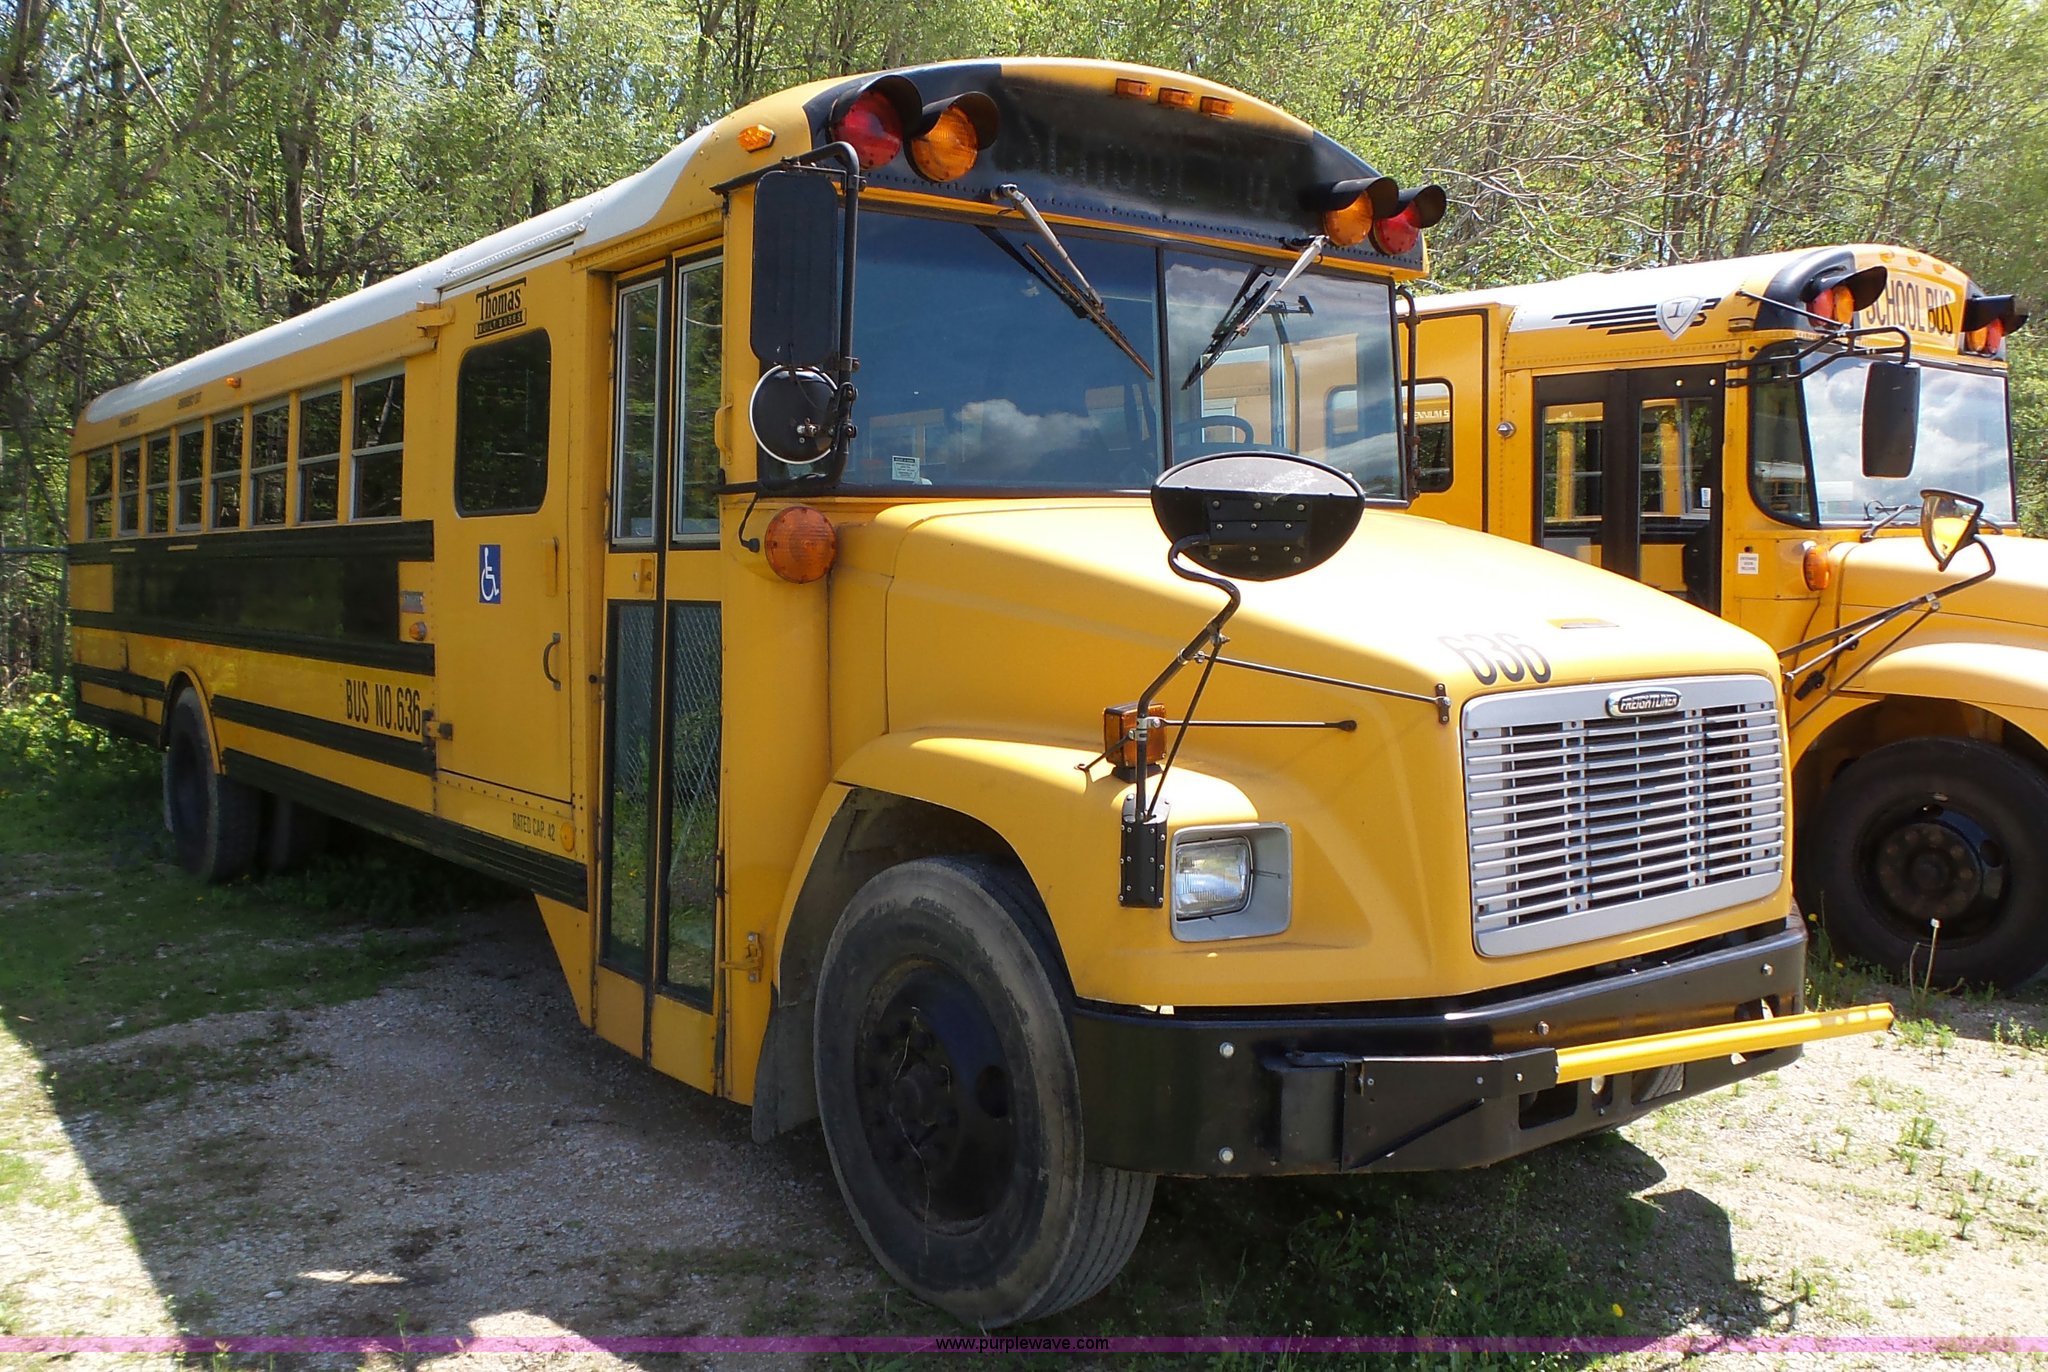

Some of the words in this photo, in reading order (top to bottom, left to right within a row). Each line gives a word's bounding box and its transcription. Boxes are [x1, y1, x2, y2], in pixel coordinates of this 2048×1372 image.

[476, 277, 527, 320] Thomas
[1926, 287, 1954, 335] BUS
[1438, 632, 1552, 686] 636
[346, 679, 369, 724] BUS
[1620, 693, 1678, 711] FREIGHTLINER
[512, 812, 531, 834] RATED
